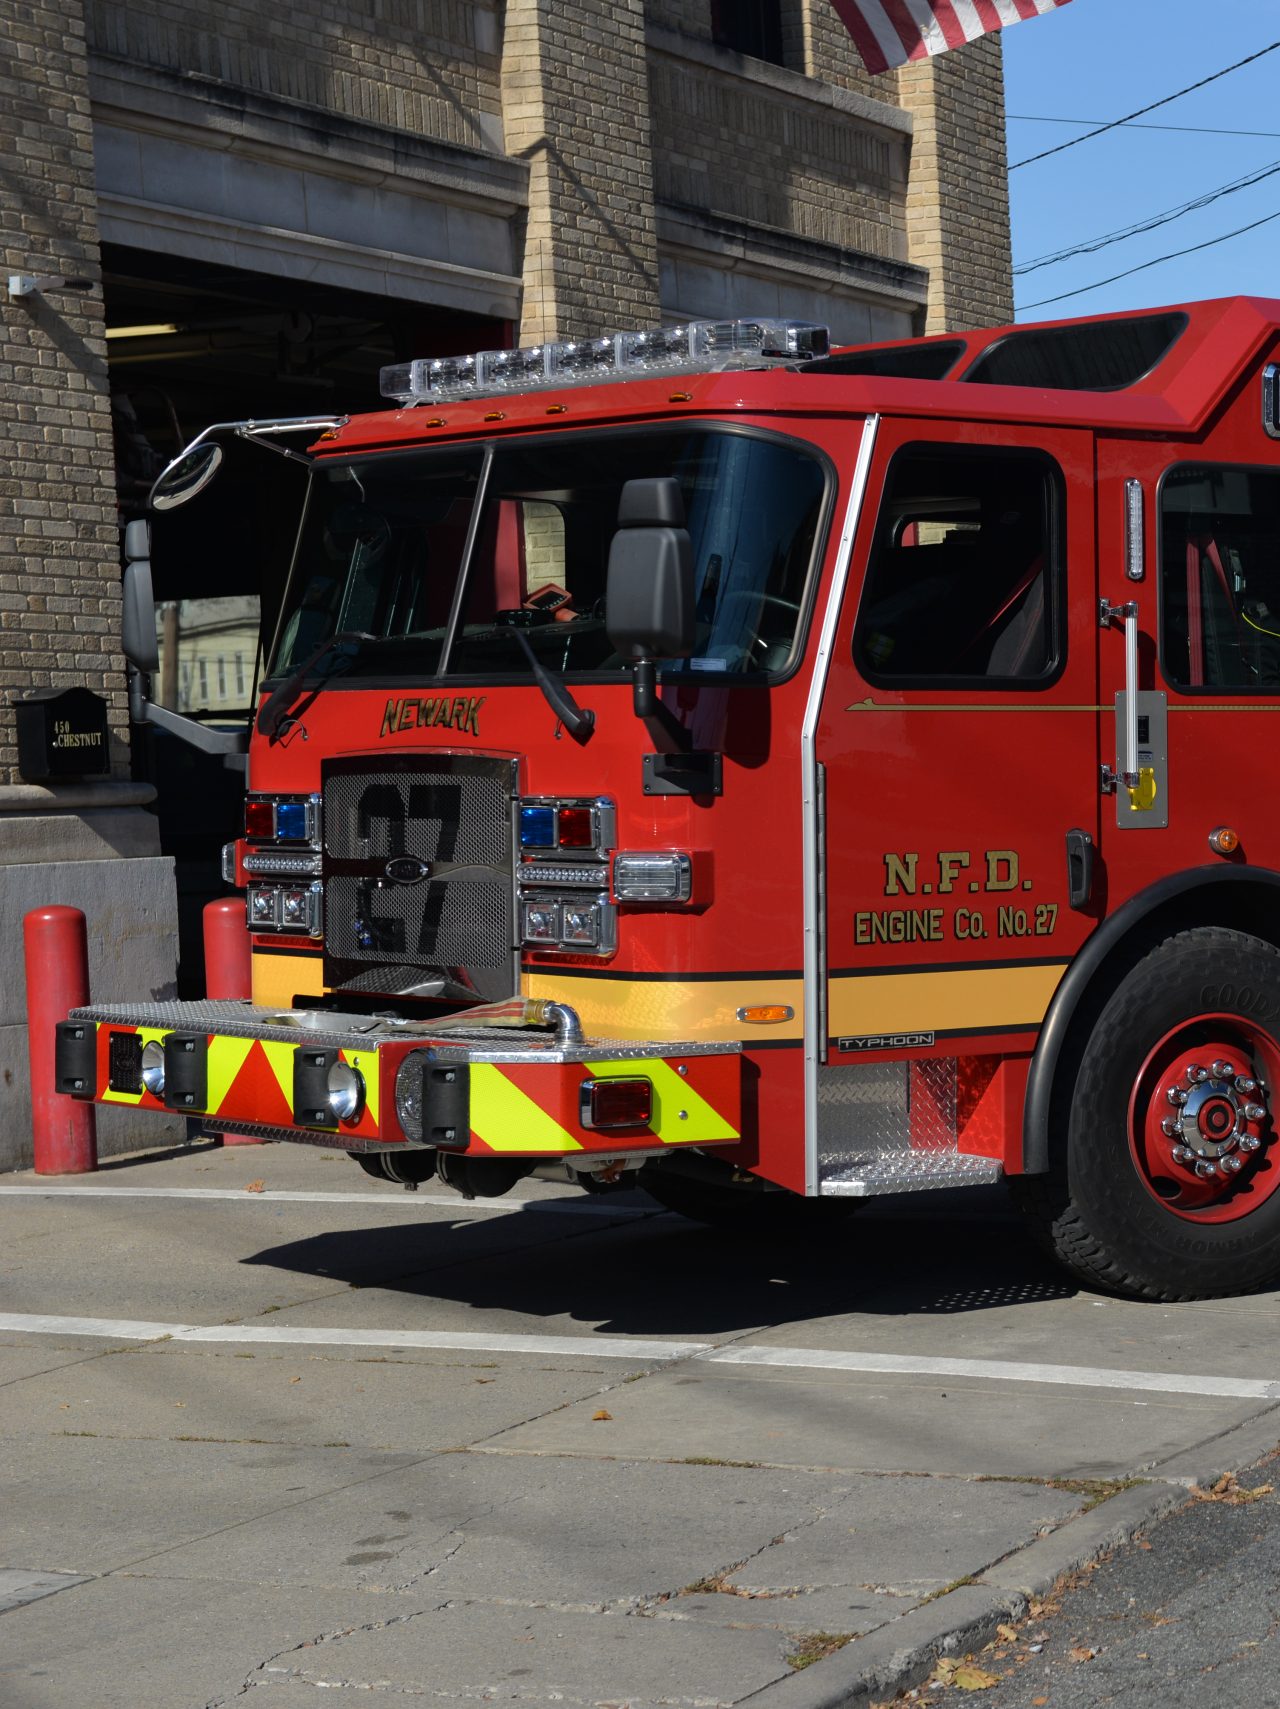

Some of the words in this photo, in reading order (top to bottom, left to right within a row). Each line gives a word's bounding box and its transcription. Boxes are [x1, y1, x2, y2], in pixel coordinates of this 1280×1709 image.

[54, 720, 70, 734] 450
[379, 697, 487, 738] NEWARK
[57, 732, 102, 747] CHESTNUT
[357, 784, 462, 953] 27
[884, 850, 1033, 895] N.F.D.
[855, 908, 944, 945] ENGINE
[954, 907, 988, 938] Co.
[998, 905, 1032, 937] No.
[1033, 903, 1058, 935] 27
[841, 1034, 932, 1049] TYPHOON
